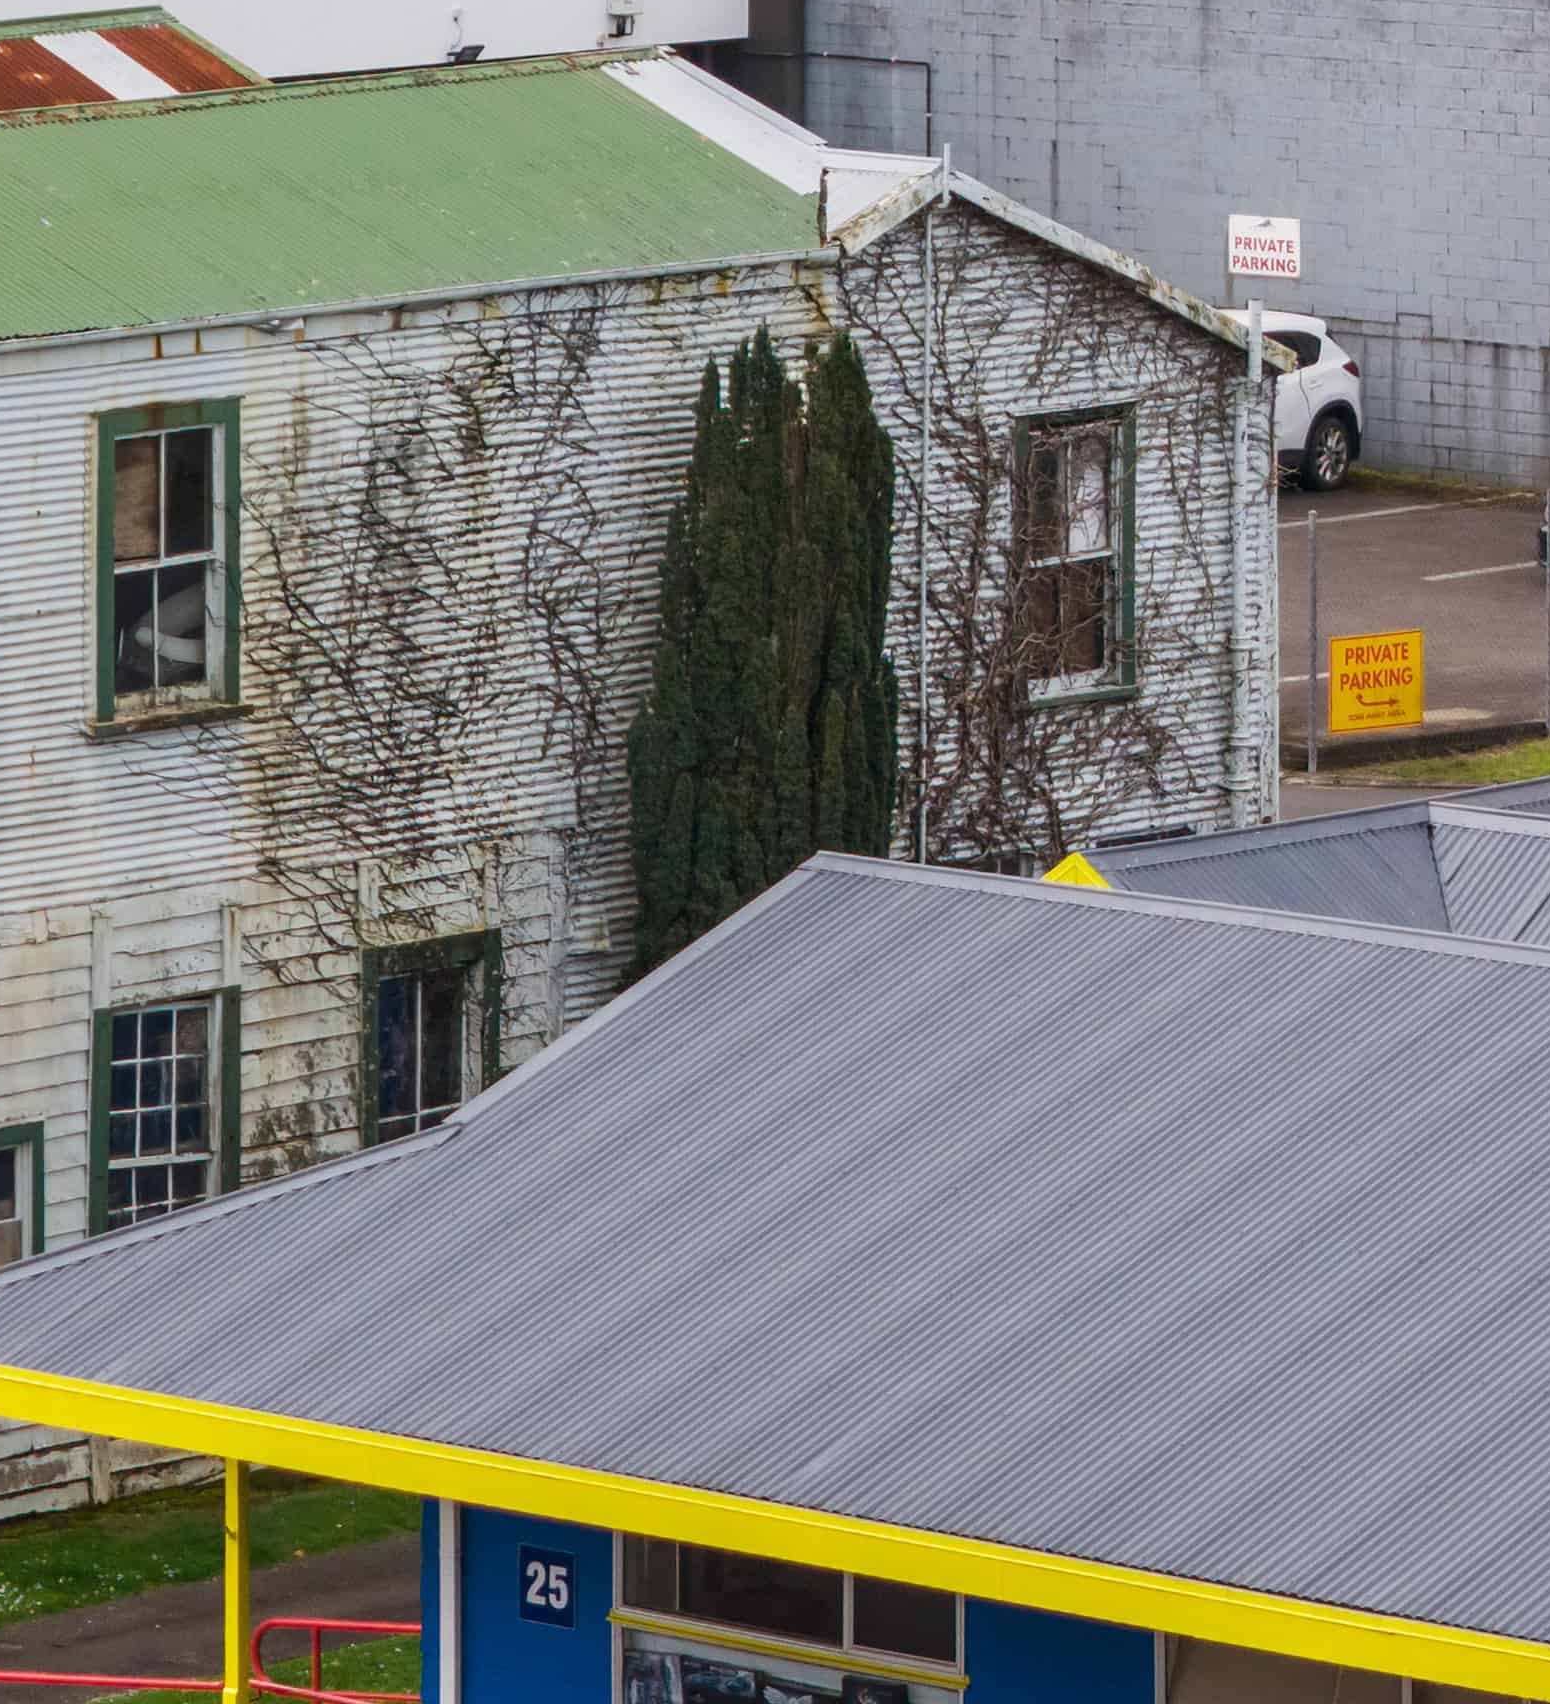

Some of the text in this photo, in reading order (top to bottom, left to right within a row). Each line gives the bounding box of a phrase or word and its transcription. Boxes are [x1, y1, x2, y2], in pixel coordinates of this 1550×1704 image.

[1234, 236, 1295, 253] PRIVATE
[1232, 255, 1297, 273] PARKING
[1345, 641, 1409, 666] PRIVATE
[1340, 667, 1413, 692] PARKING
[526, 1560, 569, 1610] 25
